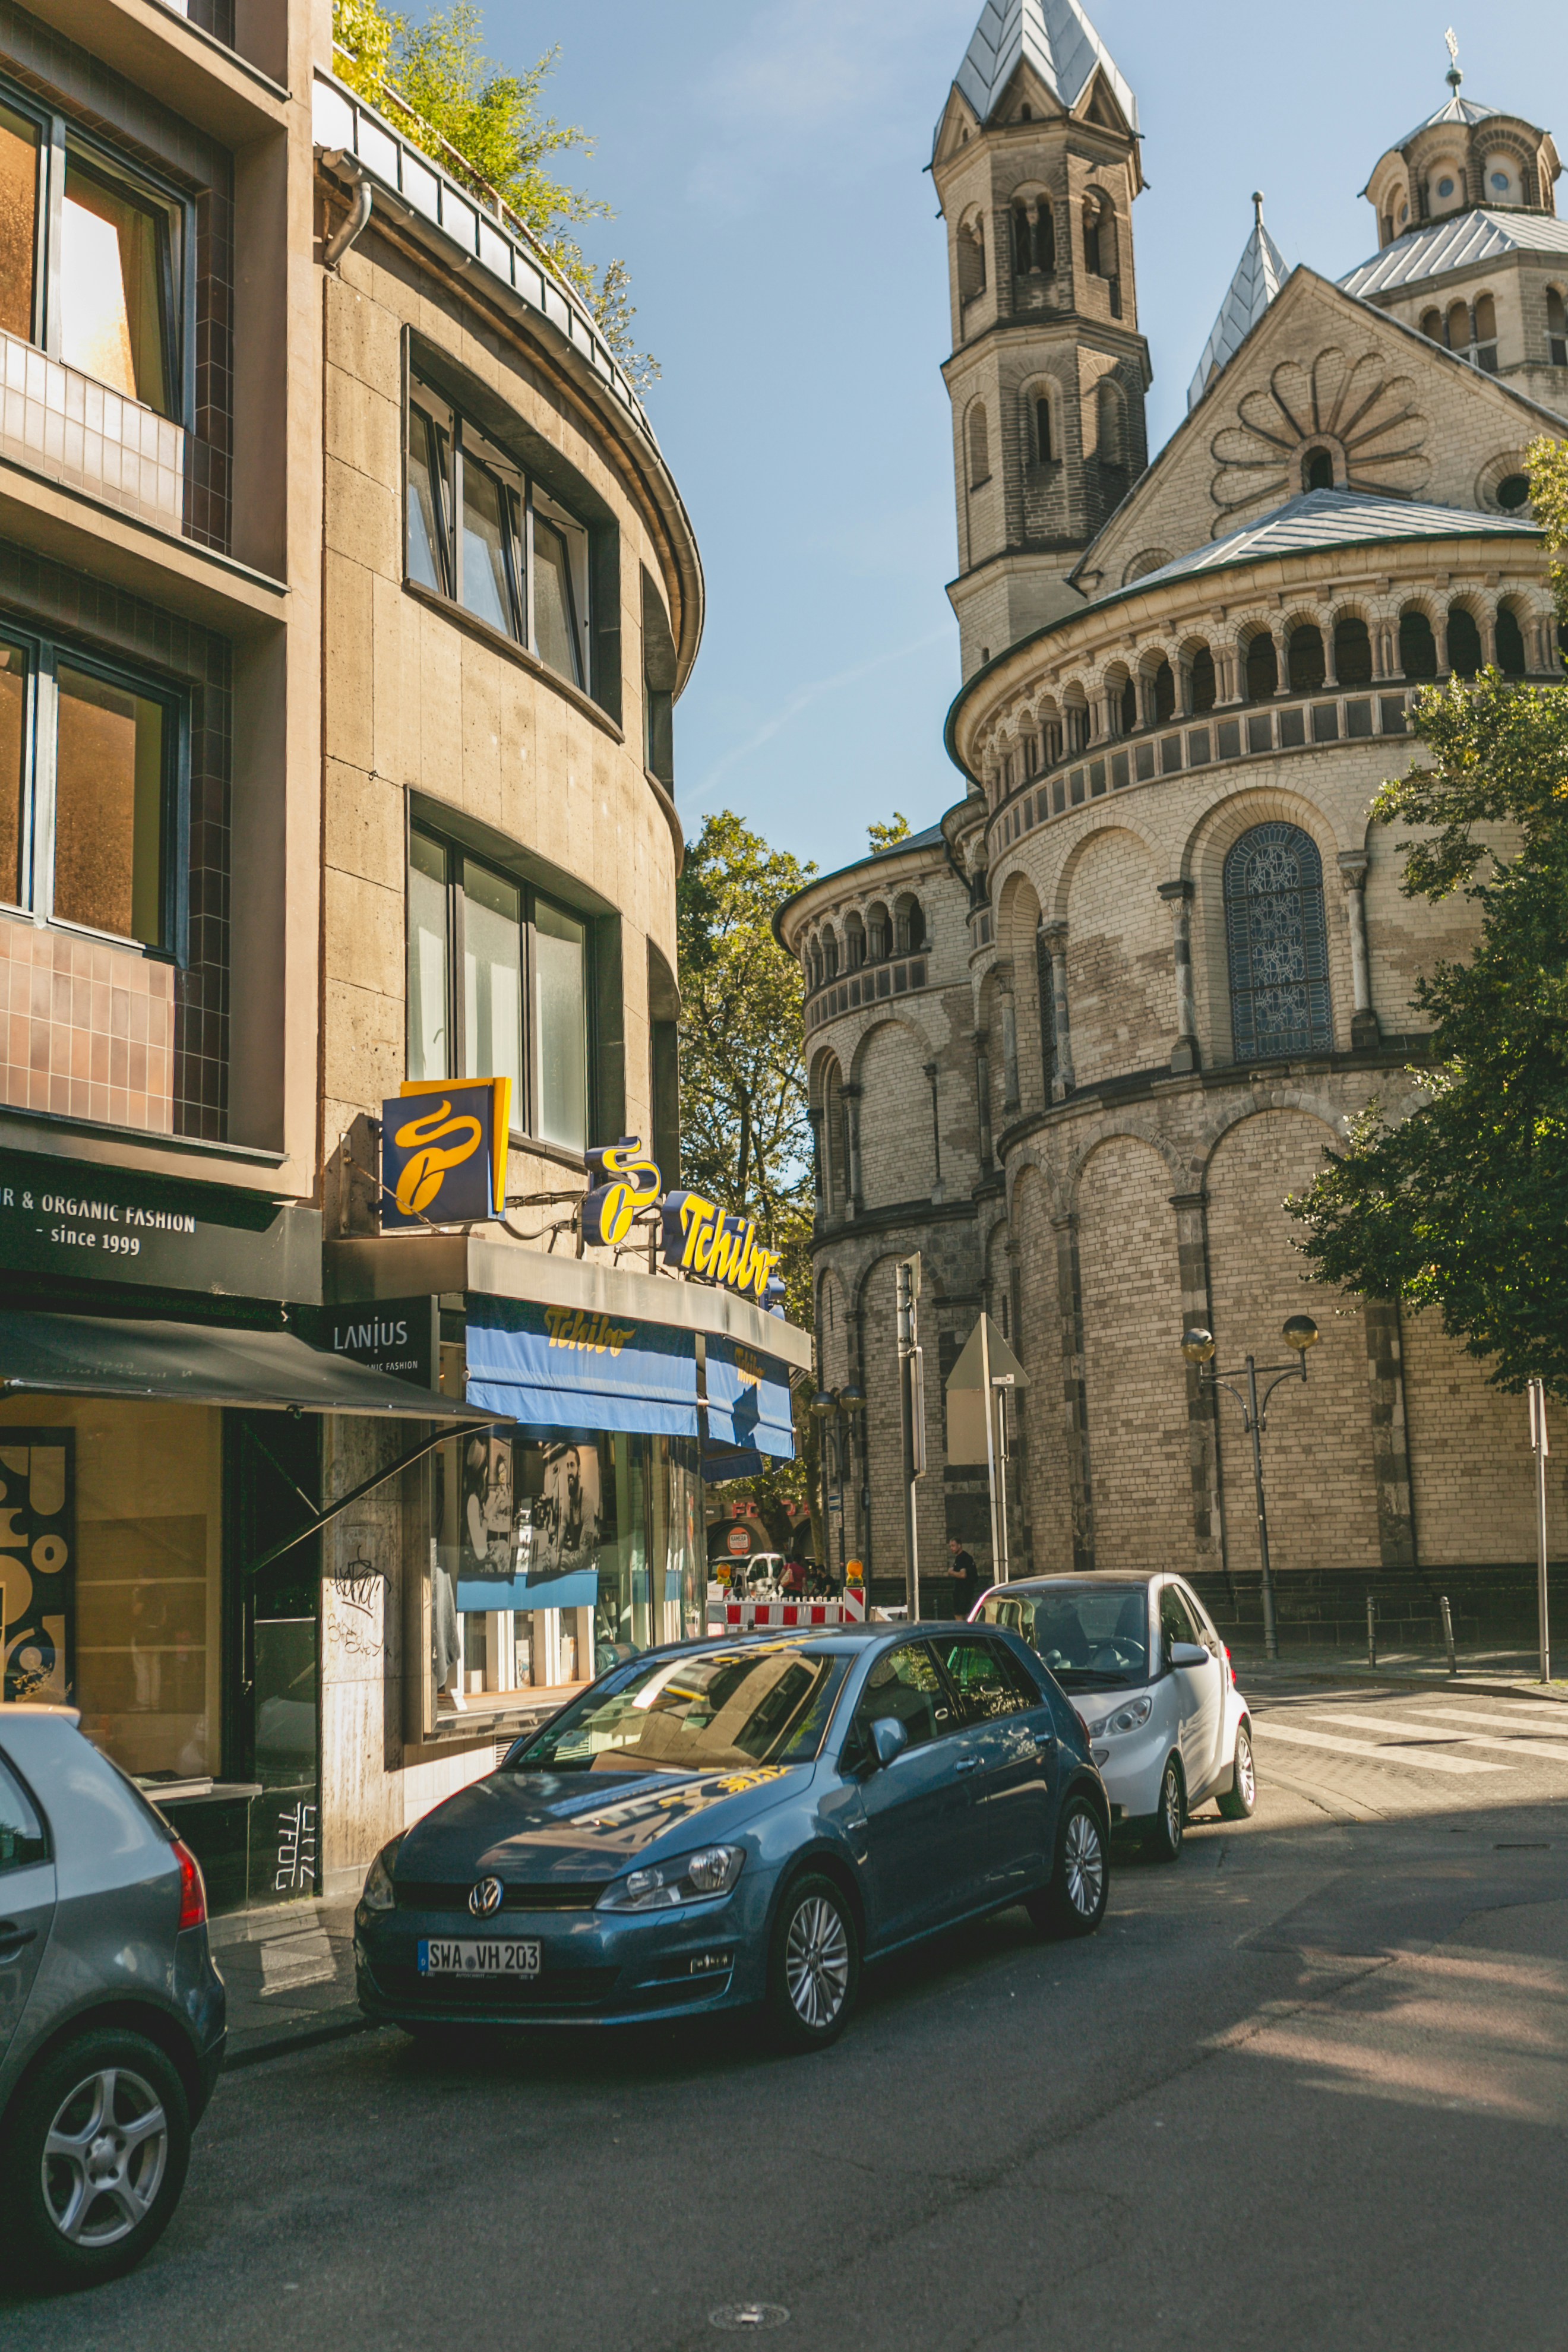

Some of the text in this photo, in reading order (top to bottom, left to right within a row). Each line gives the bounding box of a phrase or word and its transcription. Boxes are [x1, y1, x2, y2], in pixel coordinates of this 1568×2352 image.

[22, 1191, 34, 1210] &
[42, 1194, 119, 1222] ORGANIC
[125, 1206, 196, 1234] FASHION
[50, 1224, 96, 1247] since
[102, 1234, 141, 1256] 1999
[680, 1192, 780, 1297] Tchibo
[544, 1307, 637, 1358] Tchibo
[386, 1361, 418, 1371] FASHION
[429, 1944, 538, 1970] SWA VH 203
